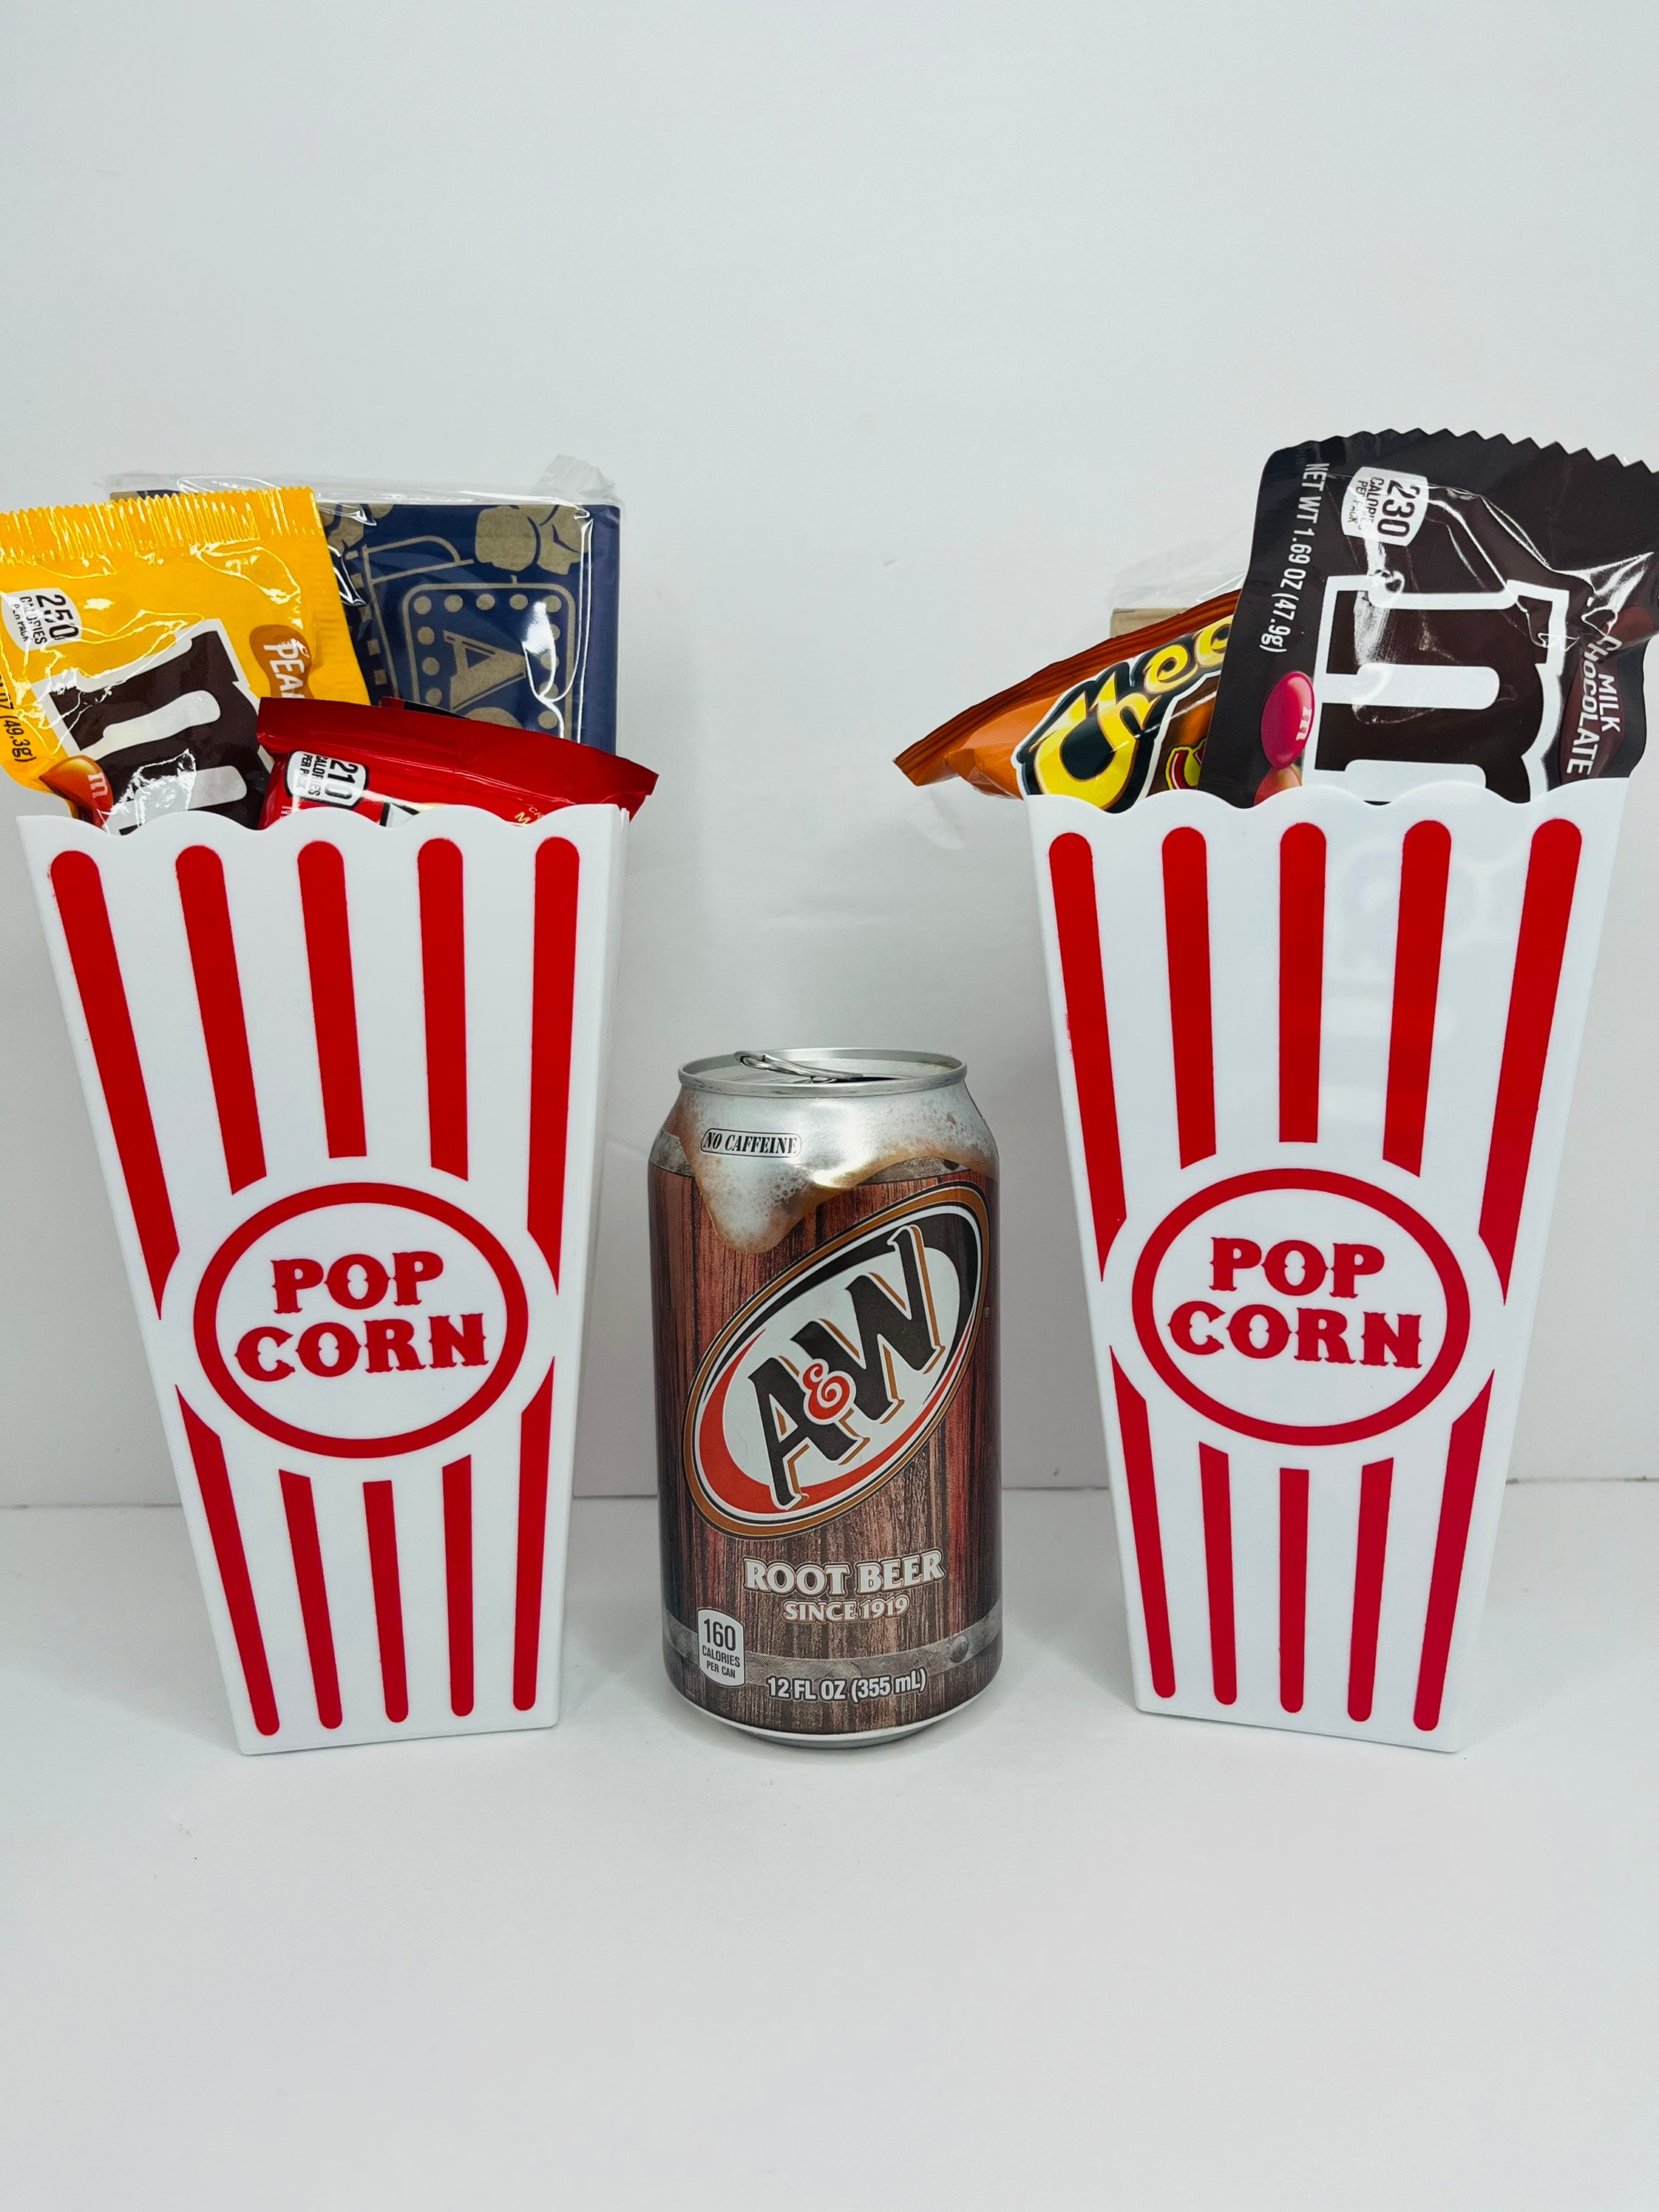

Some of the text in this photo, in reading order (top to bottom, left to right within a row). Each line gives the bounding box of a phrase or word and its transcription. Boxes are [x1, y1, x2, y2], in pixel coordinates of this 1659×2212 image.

[1355, 481, 1368, 498] PE
[1377, 479, 1420, 537] 230
[1259, 463, 1330, 653] NET WT 1.69 OZ (47.9g)
[35, 594, 79, 640] 250
[444, 631, 527, 728] A
[1598, 674, 1621, 733] MILK
[1566, 635, 1623, 776] CHOCOLATE
[0, 715, 37, 763] (49.3g)
[300, 753, 313, 767] PER
[325, 759, 359, 801] 210
[703, 1132, 798, 1154] NO CAFFEINE
[271, 1251, 444, 1314] POP
[1209, 1237, 1385, 1299] POP
[234, 1313, 489, 1382] CORN
[1167, 1300, 1423, 1368] CORN
[747, 1225, 946, 1510] A&W
[743, 1548, 946, 1597] ROOT BEER
[783, 1593, 911, 1623] SINCE 1919
[702, 1645, 741, 1668] CALORIES
[704, 1618, 736, 1652] 160
[706, 1661, 736, 1679] PER CAN
[767, 1667, 928, 1703] 12 FL OZ (355 mL)
